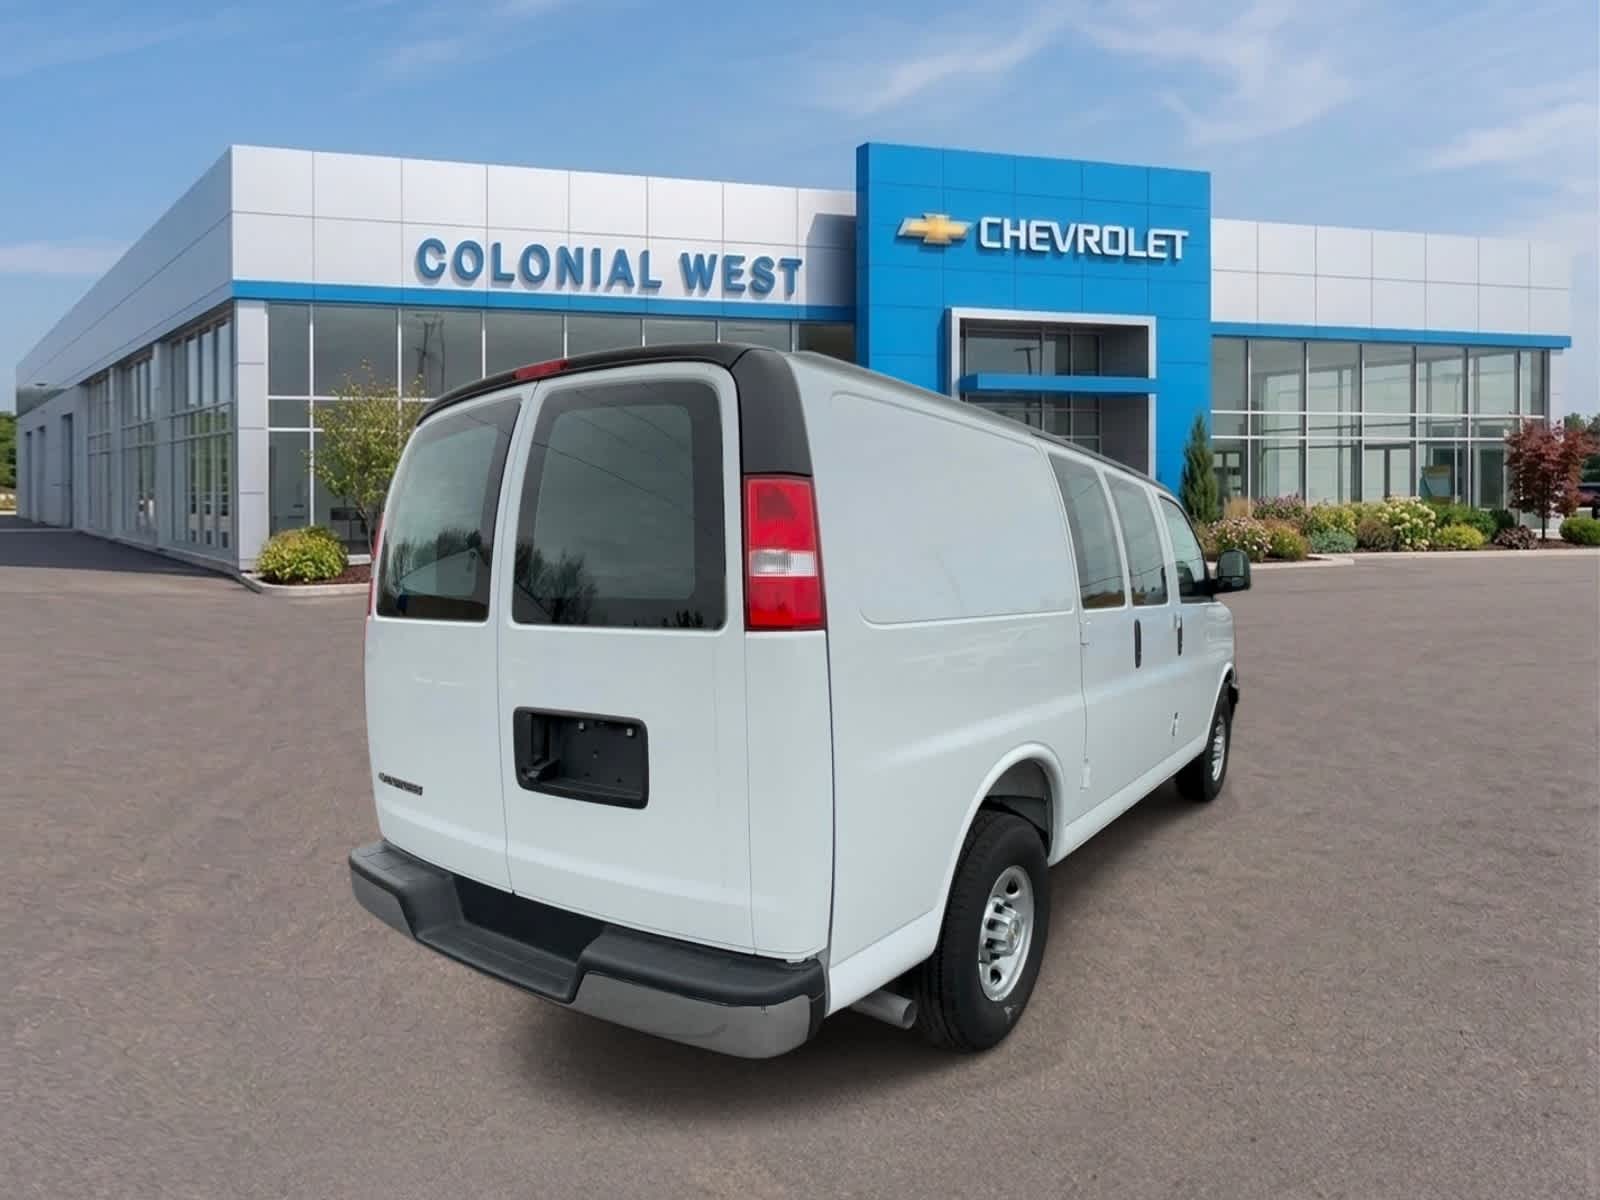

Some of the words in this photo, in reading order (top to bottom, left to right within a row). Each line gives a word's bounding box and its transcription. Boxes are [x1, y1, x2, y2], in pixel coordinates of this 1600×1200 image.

[980, 216, 1189, 260] CHEVROLET
[416, 238, 662, 289] COLONIAL
[680, 252, 802, 295] WEST
